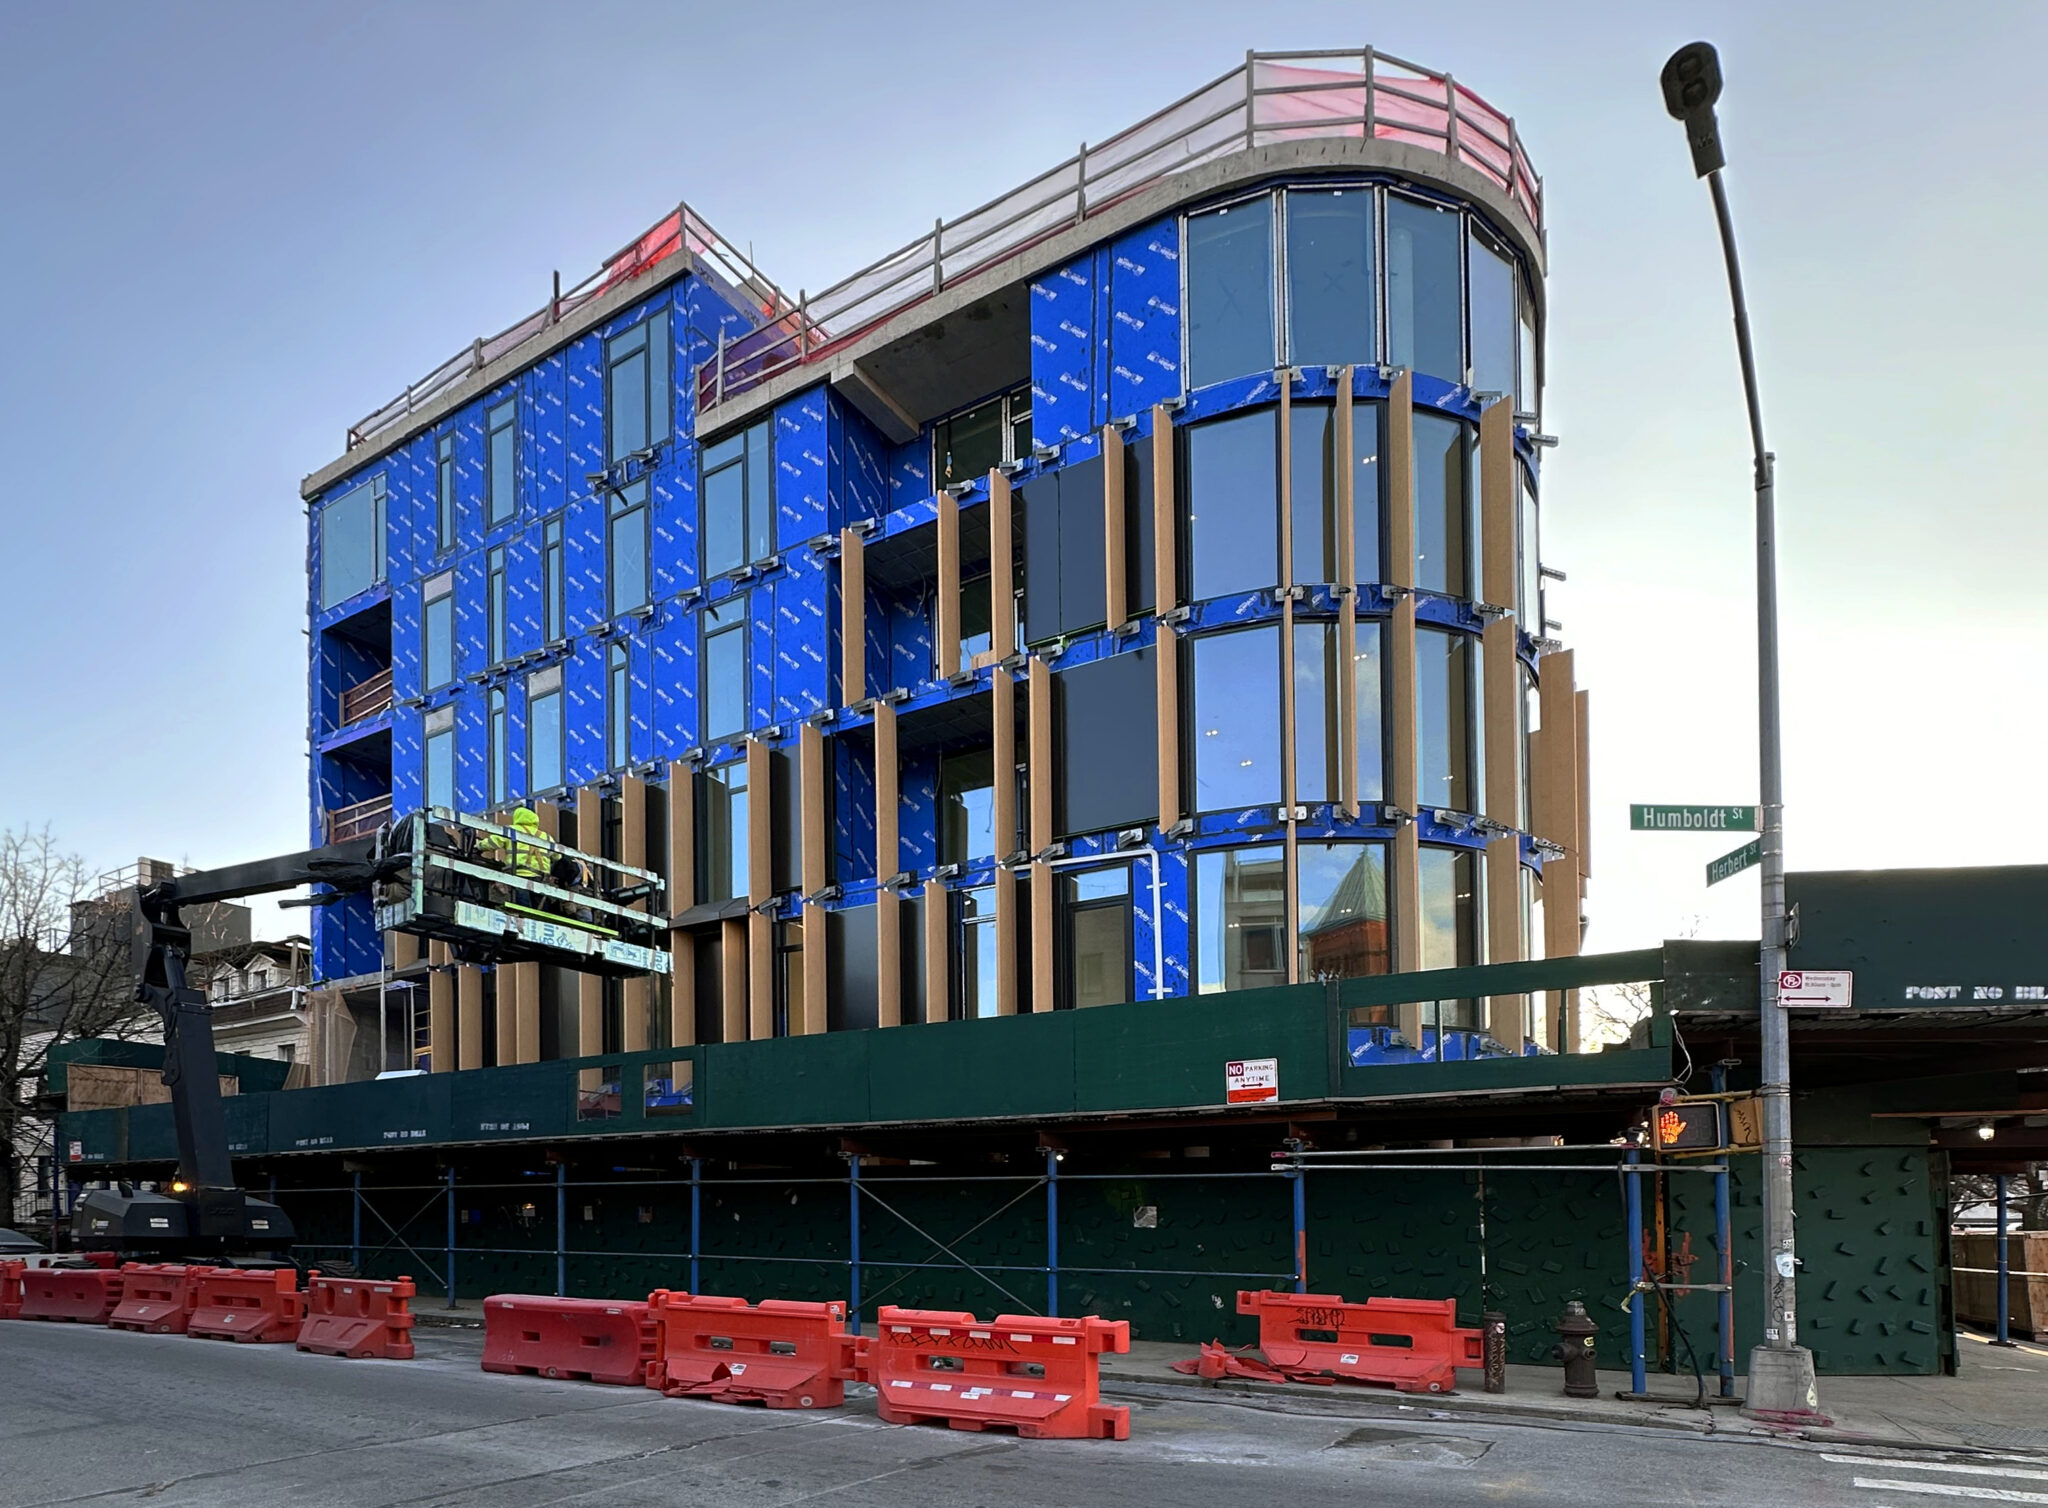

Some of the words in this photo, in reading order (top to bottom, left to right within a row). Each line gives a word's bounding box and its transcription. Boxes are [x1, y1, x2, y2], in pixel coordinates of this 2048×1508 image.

[1643, 807, 1727, 828] Humboldt
[1732, 807, 1743, 819] St
[1711, 850, 1747, 880] Herbert
[1906, 986, 1961, 999] POST
[1973, 986, 2004, 999] NO
[1229, 1065, 1242, 1075] NO
[1235, 1075, 1269, 1083] ANYTIME
